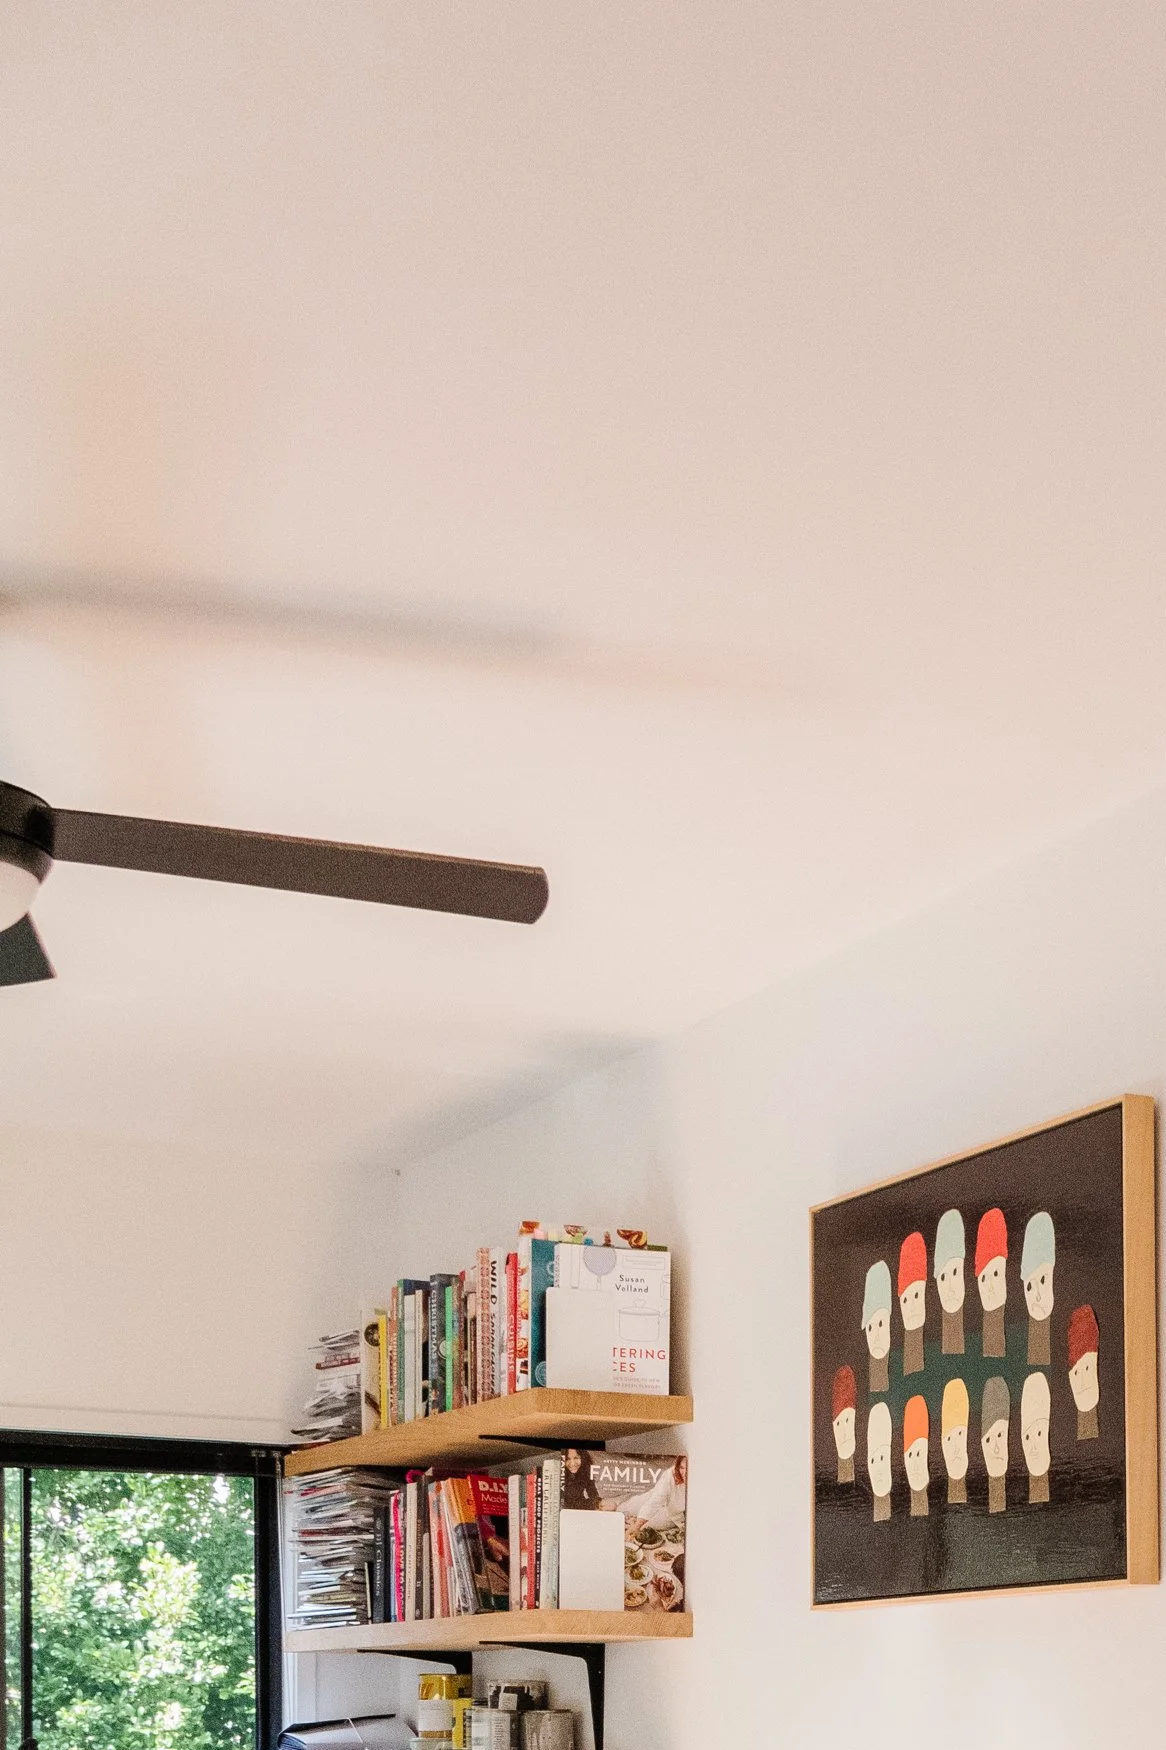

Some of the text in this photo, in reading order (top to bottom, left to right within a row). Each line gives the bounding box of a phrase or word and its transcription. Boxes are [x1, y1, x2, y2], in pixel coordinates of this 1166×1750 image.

[490, 1260, 498, 1305] WILD
[619, 1274, 646, 1284] Susan
[615, 1284, 650, 1294] Volland
[612, 1347, 666, 1360] TERING
[589, 1464, 662, 1484] FAMILY
